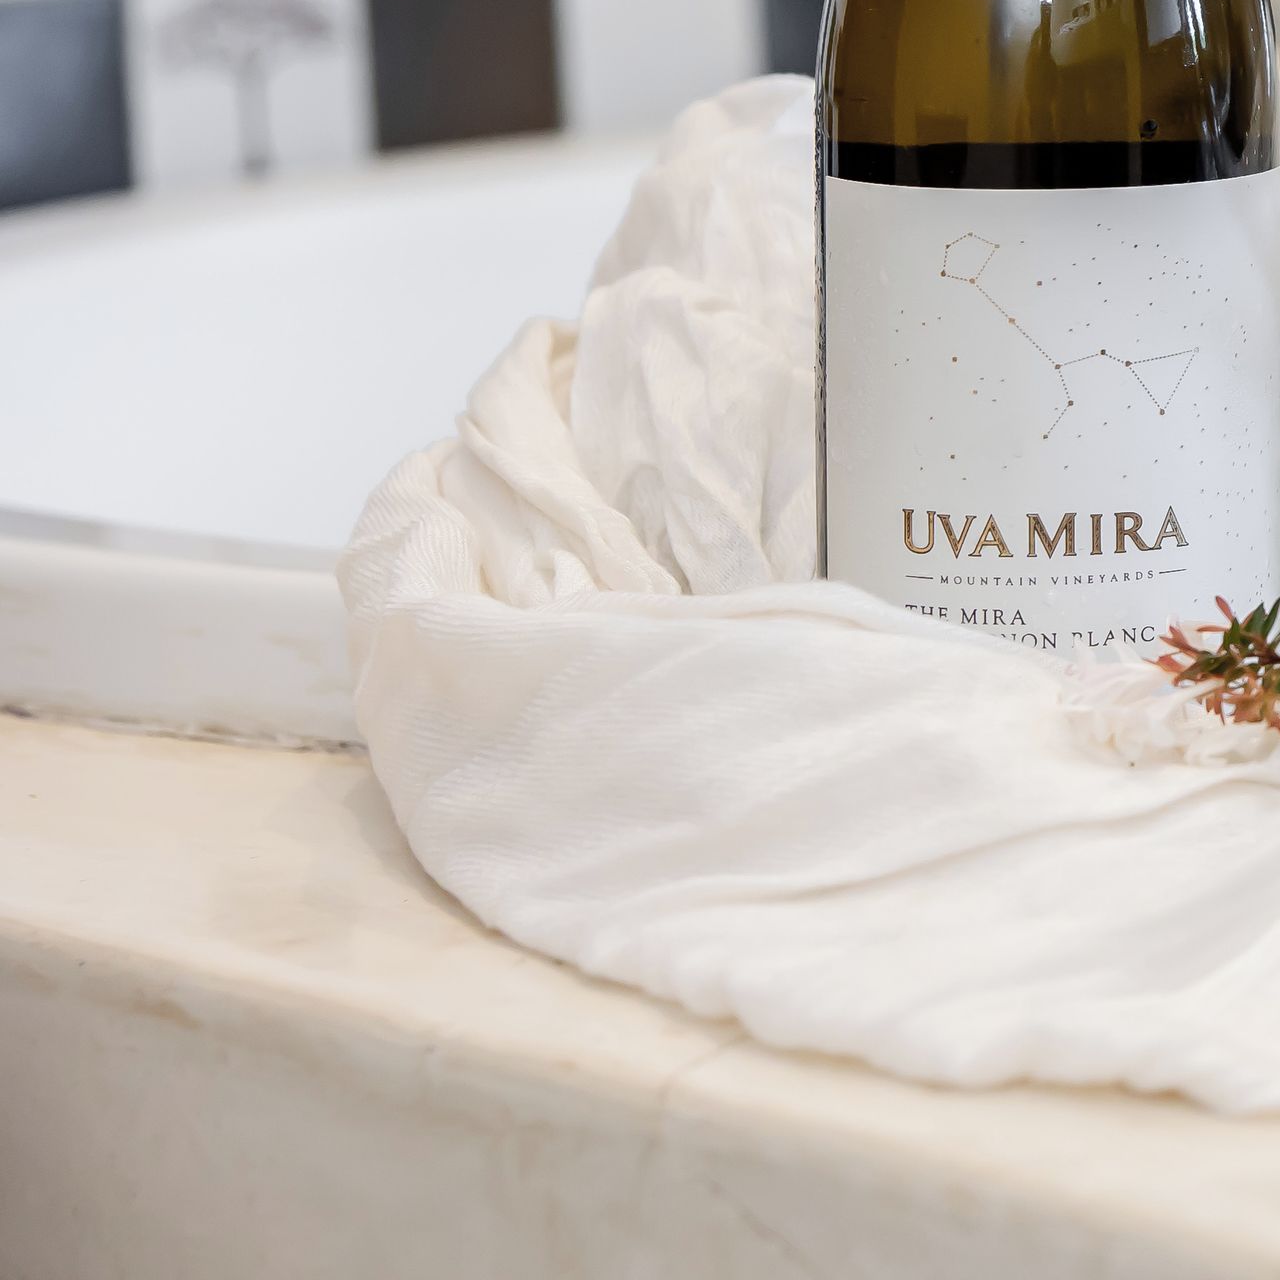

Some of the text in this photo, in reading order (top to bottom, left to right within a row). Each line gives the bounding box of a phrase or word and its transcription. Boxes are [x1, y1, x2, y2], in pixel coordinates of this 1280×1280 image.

[902, 505, 1190, 559] UVA MIRA
[940, 570, 1155, 586] MOUNTAIN VINEYARDS
[960, 607, 1027, 626] MIRA
